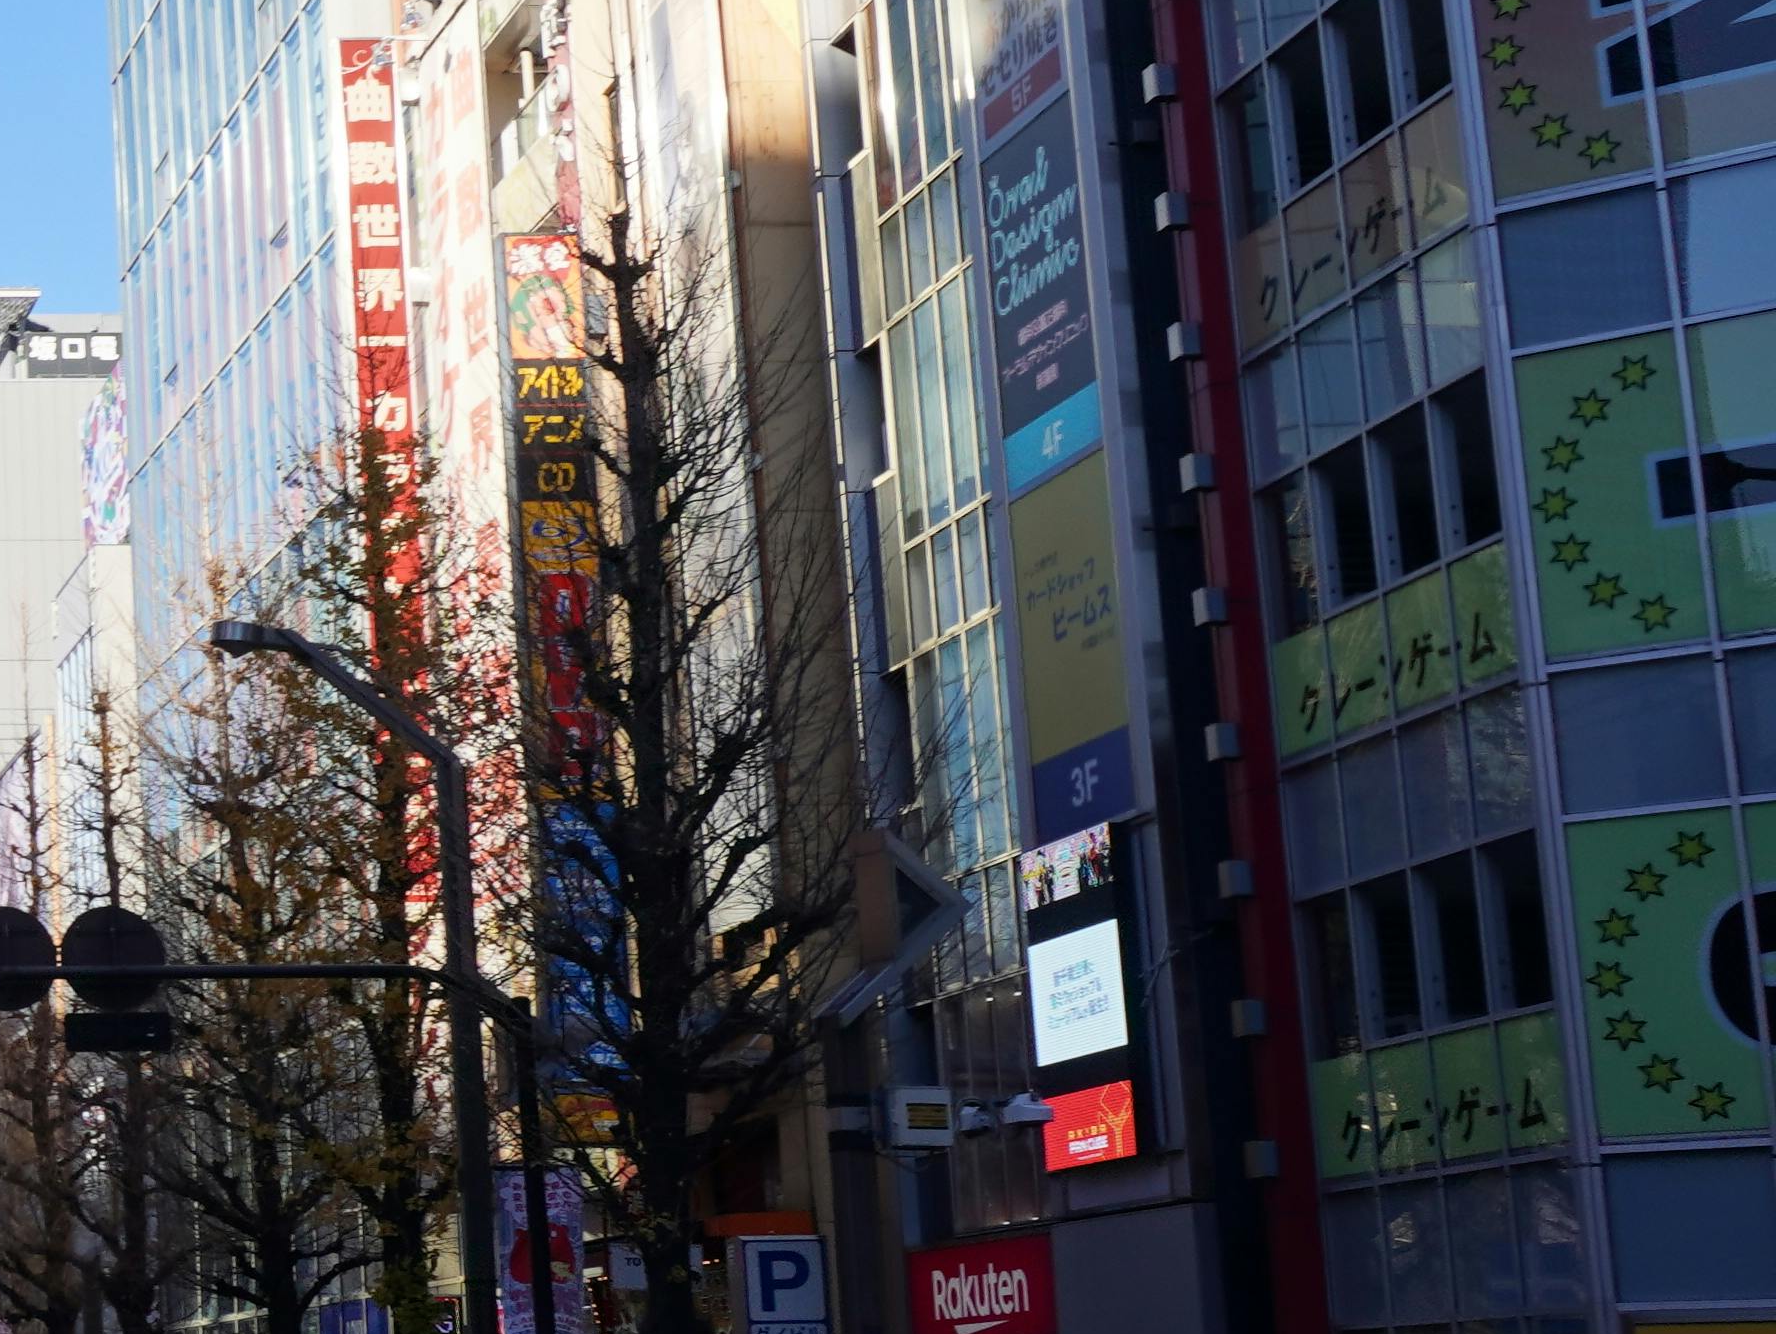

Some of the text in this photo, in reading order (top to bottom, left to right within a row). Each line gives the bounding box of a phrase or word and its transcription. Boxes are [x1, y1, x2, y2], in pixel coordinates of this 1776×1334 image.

[1011, 81, 1032, 114] 5F
[1041, 420, 1064, 459] 4F
[537, 463, 576, 493] CD
[1300, 613, 1496, 734] クレーンゲーム
[1070, 759, 1099, 807] 3F
[1344, 1079, 1547, 1162] クレーンゲーム
[757, 1250, 810, 1313] P
[931, 1263, 1031, 1322] Rakuten
